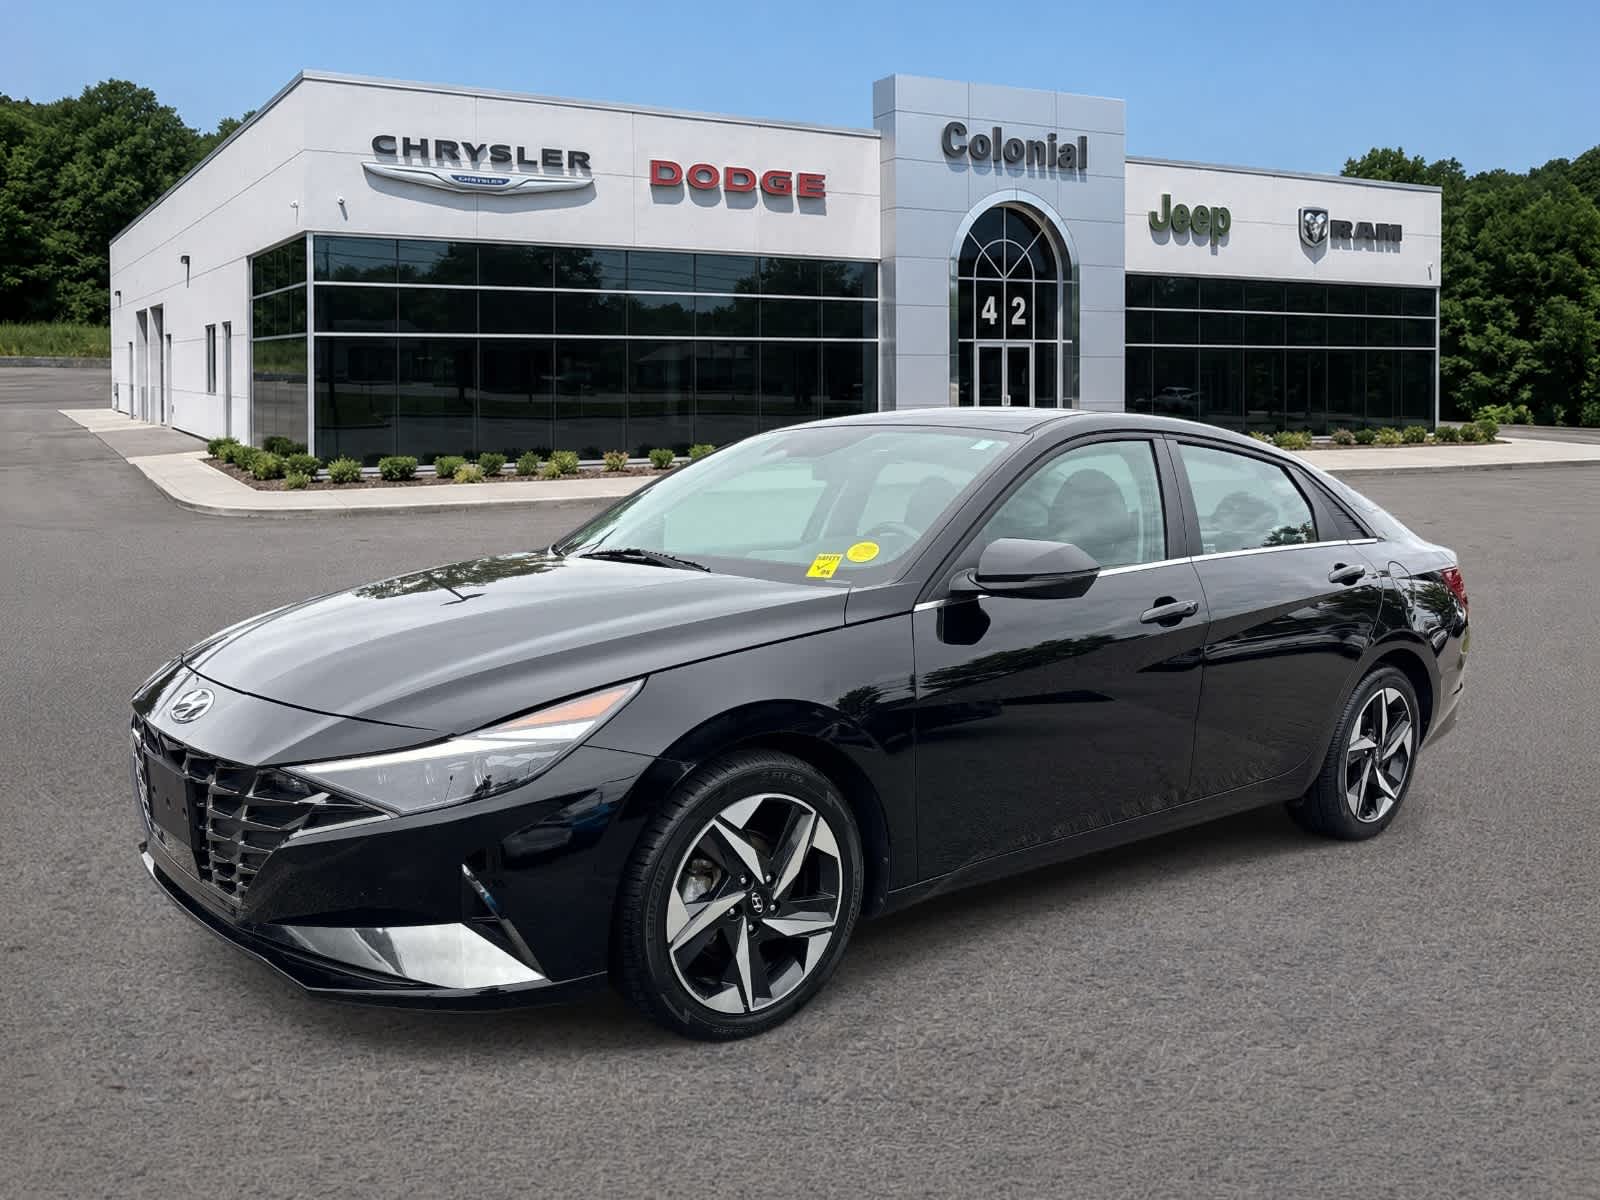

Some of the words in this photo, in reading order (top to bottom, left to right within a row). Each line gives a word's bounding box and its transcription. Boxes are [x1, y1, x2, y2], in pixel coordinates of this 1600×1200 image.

[371, 135, 591, 169] CHRYSLER
[942, 122, 1088, 169] Colonial
[650, 160, 826, 198] DODGE
[1149, 194, 1232, 245] Jeep
[1330, 219, 1402, 242] RAM
